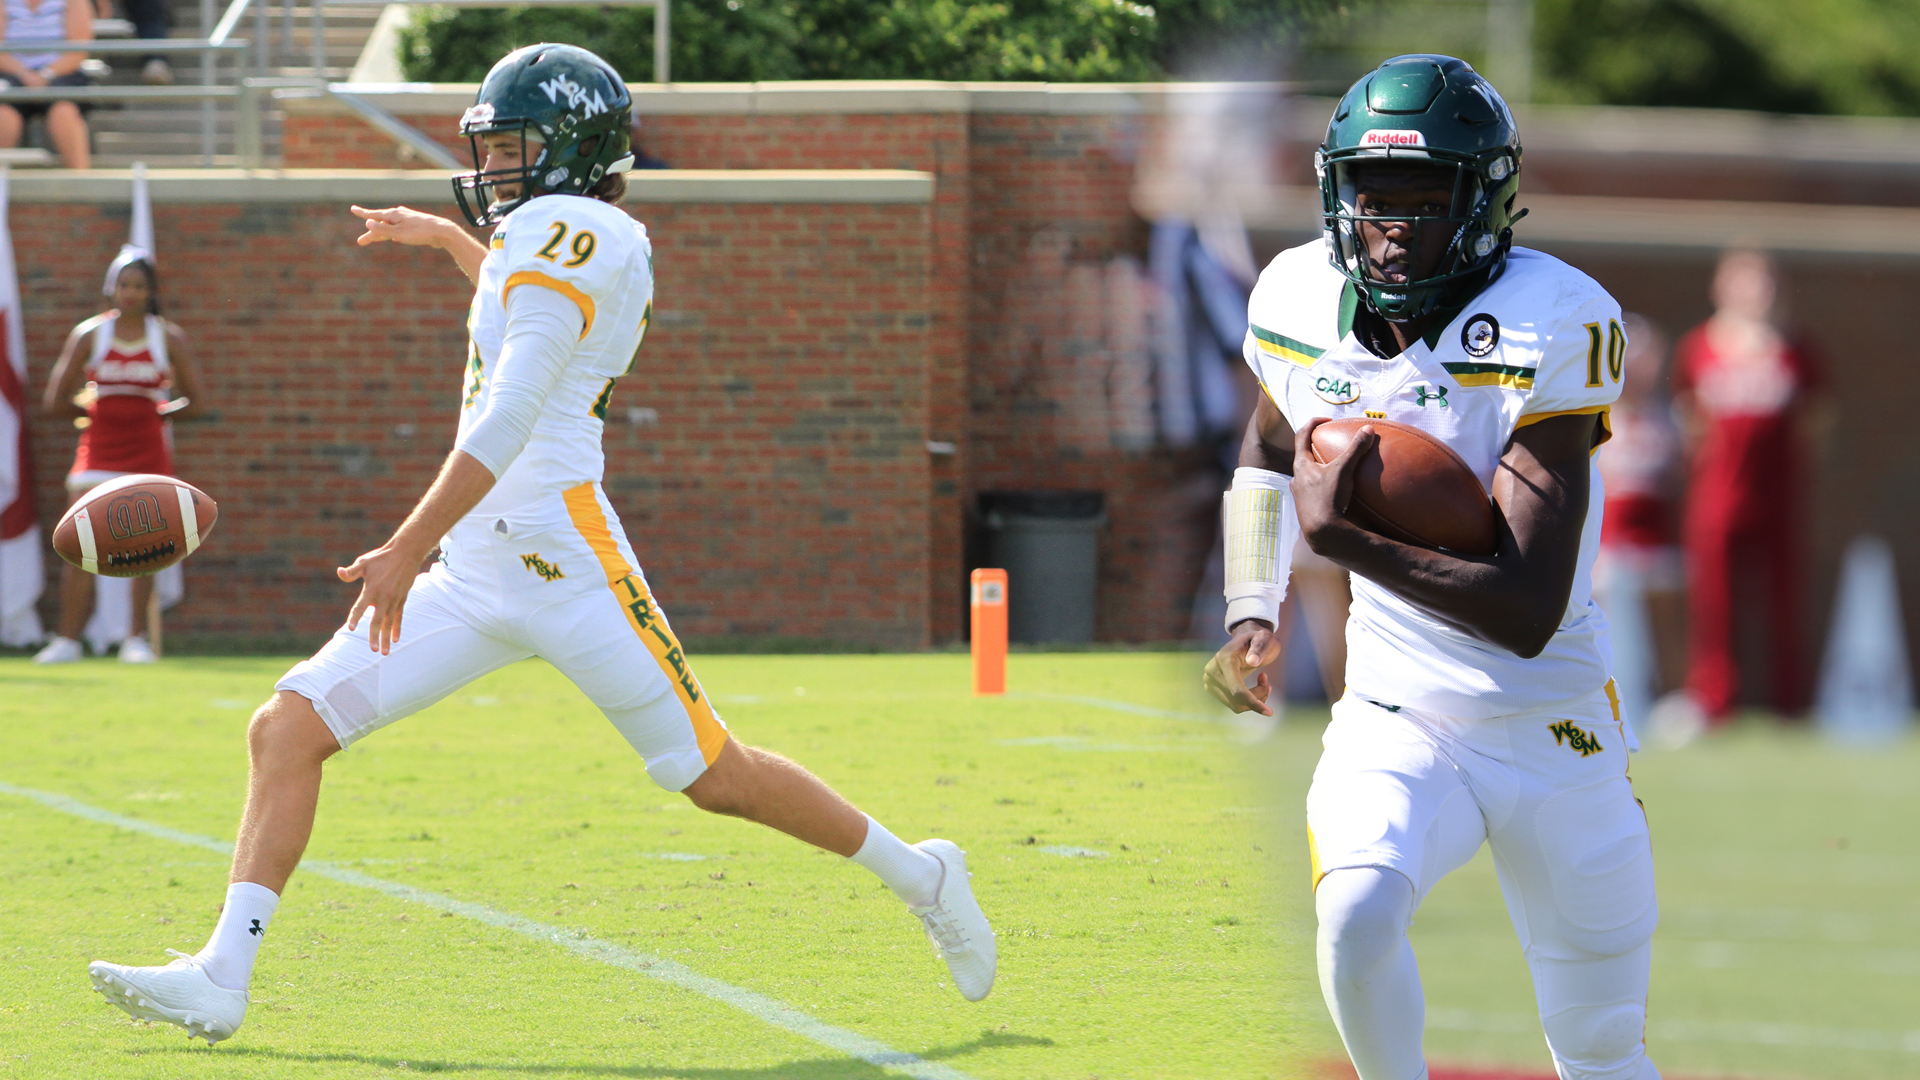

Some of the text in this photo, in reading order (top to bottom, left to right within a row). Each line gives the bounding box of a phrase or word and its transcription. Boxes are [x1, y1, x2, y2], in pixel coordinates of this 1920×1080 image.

[1367, 133, 1418, 144] Riddell
[534, 220, 598, 269] 29
[1583, 318, 1629, 388] 10
[1316, 376, 1351, 397] CAA
[519, 553, 566, 582] W&M
[615, 575, 700, 704] TRIBE
[1547, 720, 1604, 758] W&M
